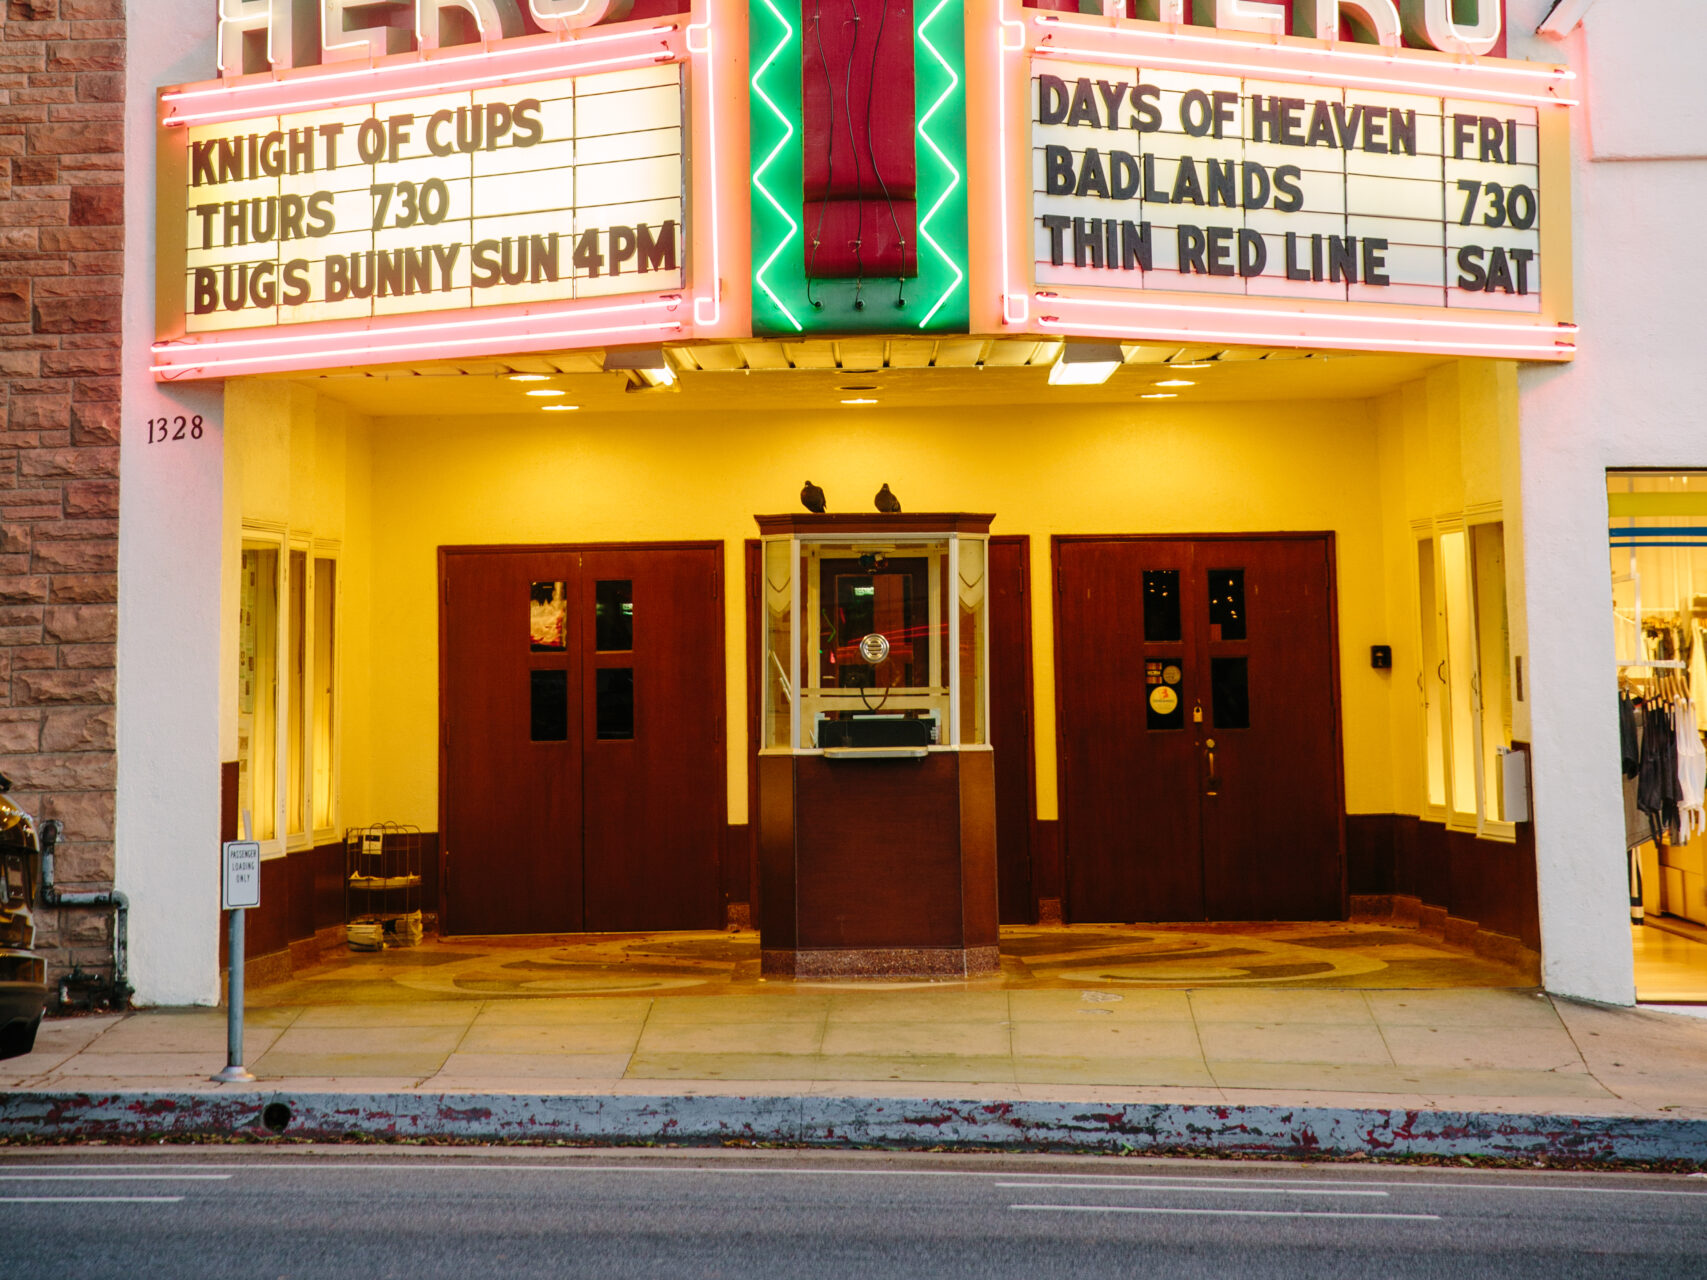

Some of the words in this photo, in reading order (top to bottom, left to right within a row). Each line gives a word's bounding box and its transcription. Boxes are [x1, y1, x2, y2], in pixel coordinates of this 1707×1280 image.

[192, 123, 344, 186] KNIGHT
[358, 114, 414, 164] OF
[426, 99, 542, 156] CUPS
[1039, 74, 1162, 132] DAYS
[1180, 89, 1238, 139] OF
[1252, 94, 1416, 155] HEAVEN
[1453, 113, 1517, 165] FRI
[196, 191, 335, 250] THURS
[370, 177, 450, 232] 730
[1045, 145, 1303, 212] BADLANDS
[1457, 179, 1536, 230] 730
[193, 258, 311, 314] BUGS
[325, 243, 461, 302] BUNNY
[472, 232, 559, 288] SUN
[572, 220, 676, 278] 4PM
[1043, 215, 1152, 271] THIN
[1178, 225, 1267, 277] RED
[1285, 232, 1390, 286] LINE
[1457, 245, 1533, 295] SAT
[147, 415, 204, 445] 1328
[232, 861, 254, 871] LOADING
[236, 874, 250, 883] ONLY
